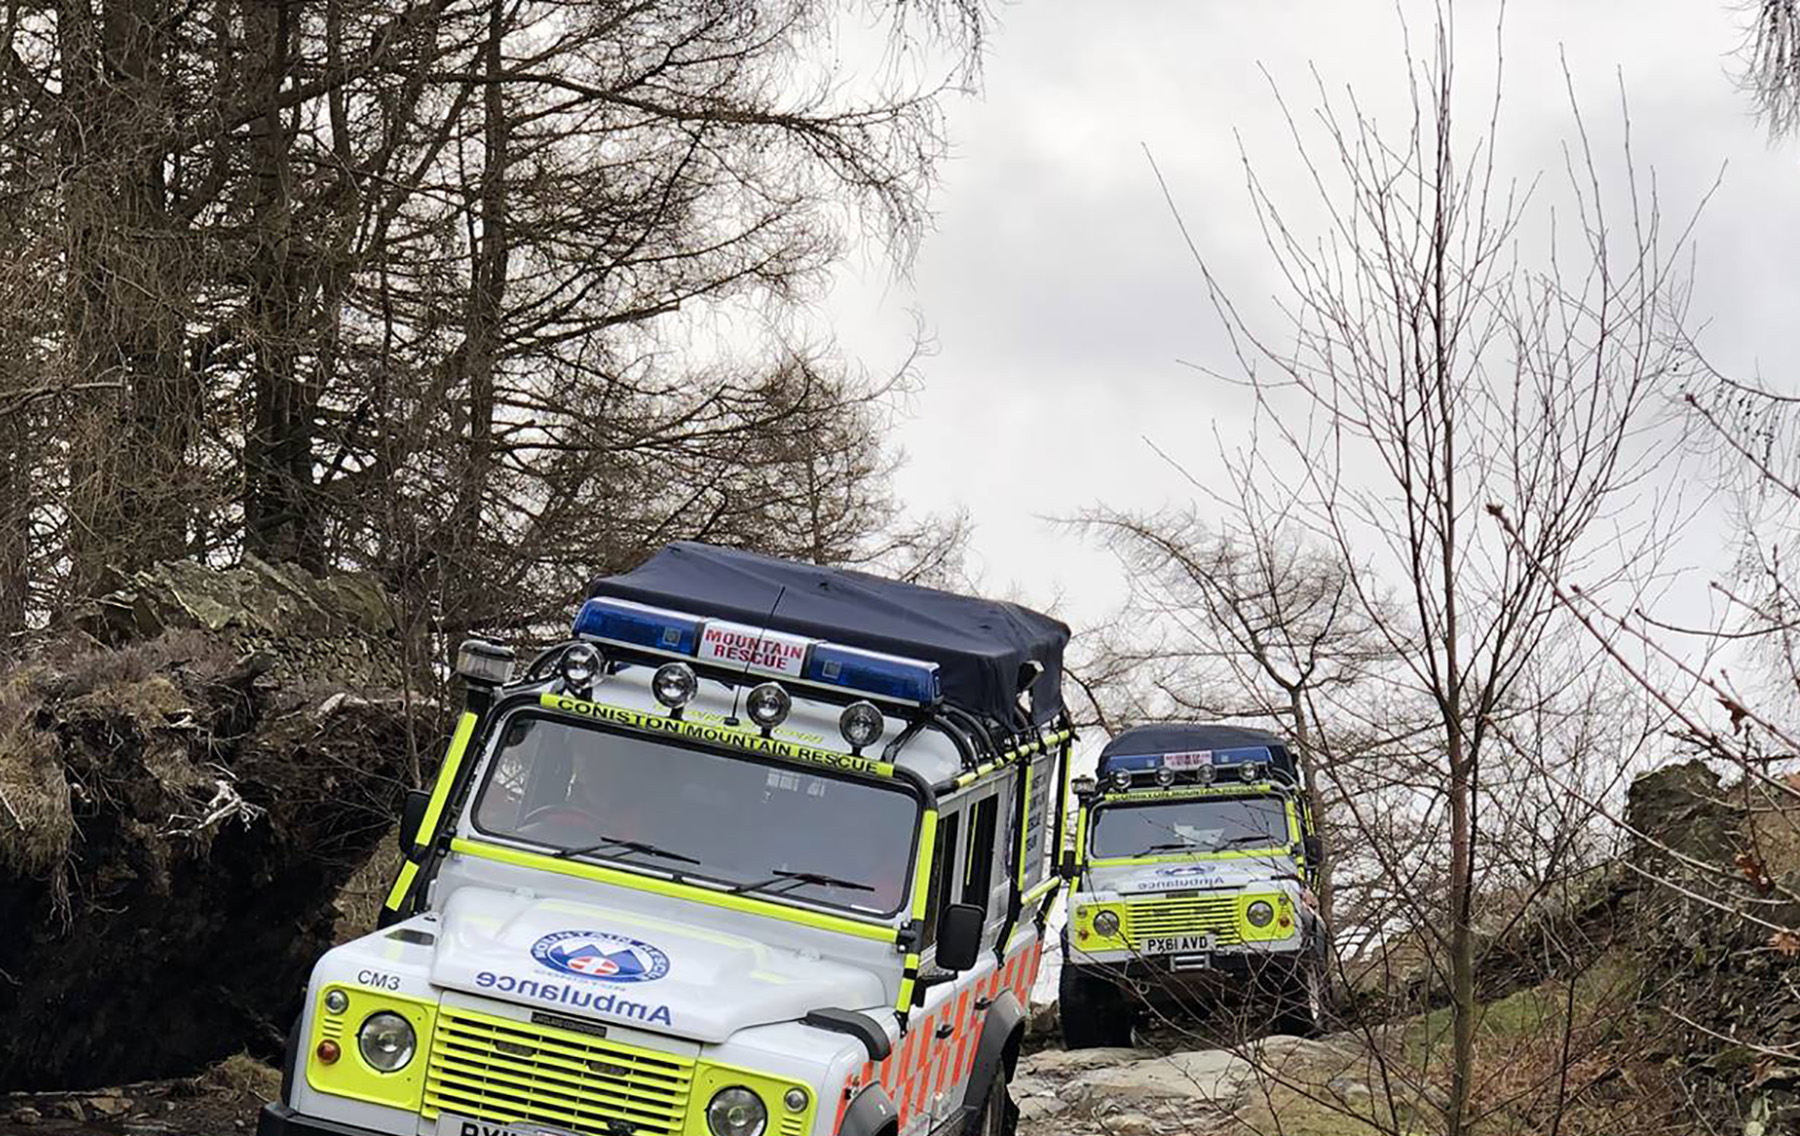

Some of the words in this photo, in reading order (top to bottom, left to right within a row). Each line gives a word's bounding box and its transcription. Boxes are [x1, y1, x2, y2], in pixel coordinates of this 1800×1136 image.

[705, 630, 803, 659] MOUNTAIN
[714, 644, 788, 671] RESCUE
[558, 699, 680, 733] CONISTON
[686, 725, 791, 756] MOUNTAIN
[798, 748, 878, 774] RESCUE
[1182, 935, 1208, 950] AVD
[358, 969, 401, 991] CM3
